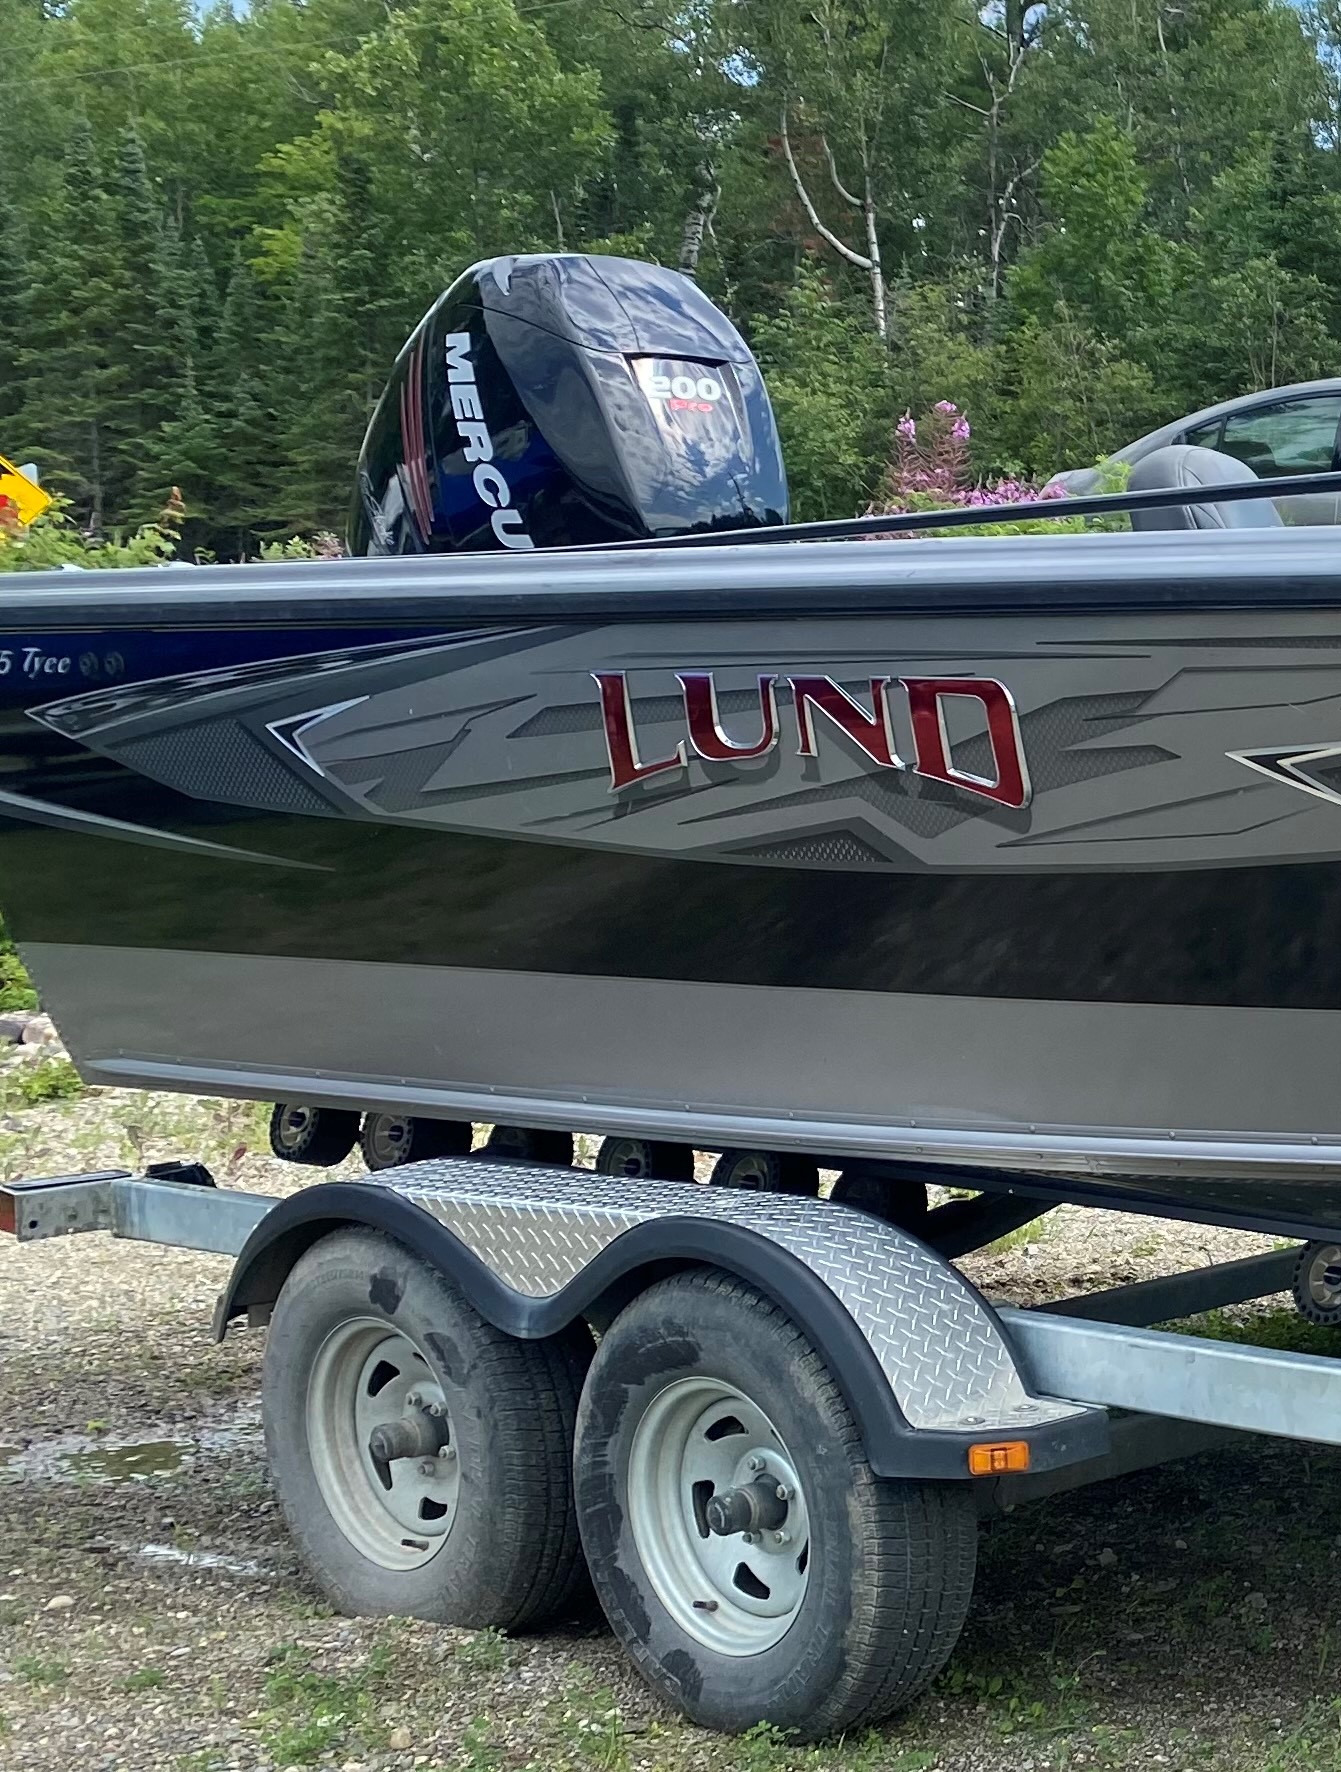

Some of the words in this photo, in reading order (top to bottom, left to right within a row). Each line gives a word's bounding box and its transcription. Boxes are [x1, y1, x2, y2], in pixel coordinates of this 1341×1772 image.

[649, 376, 721, 400] 200
[446, 332, 535, 548] MERCU
[21, 647, 72, 680] Tyee
[590, 670, 1033, 809] LUND
